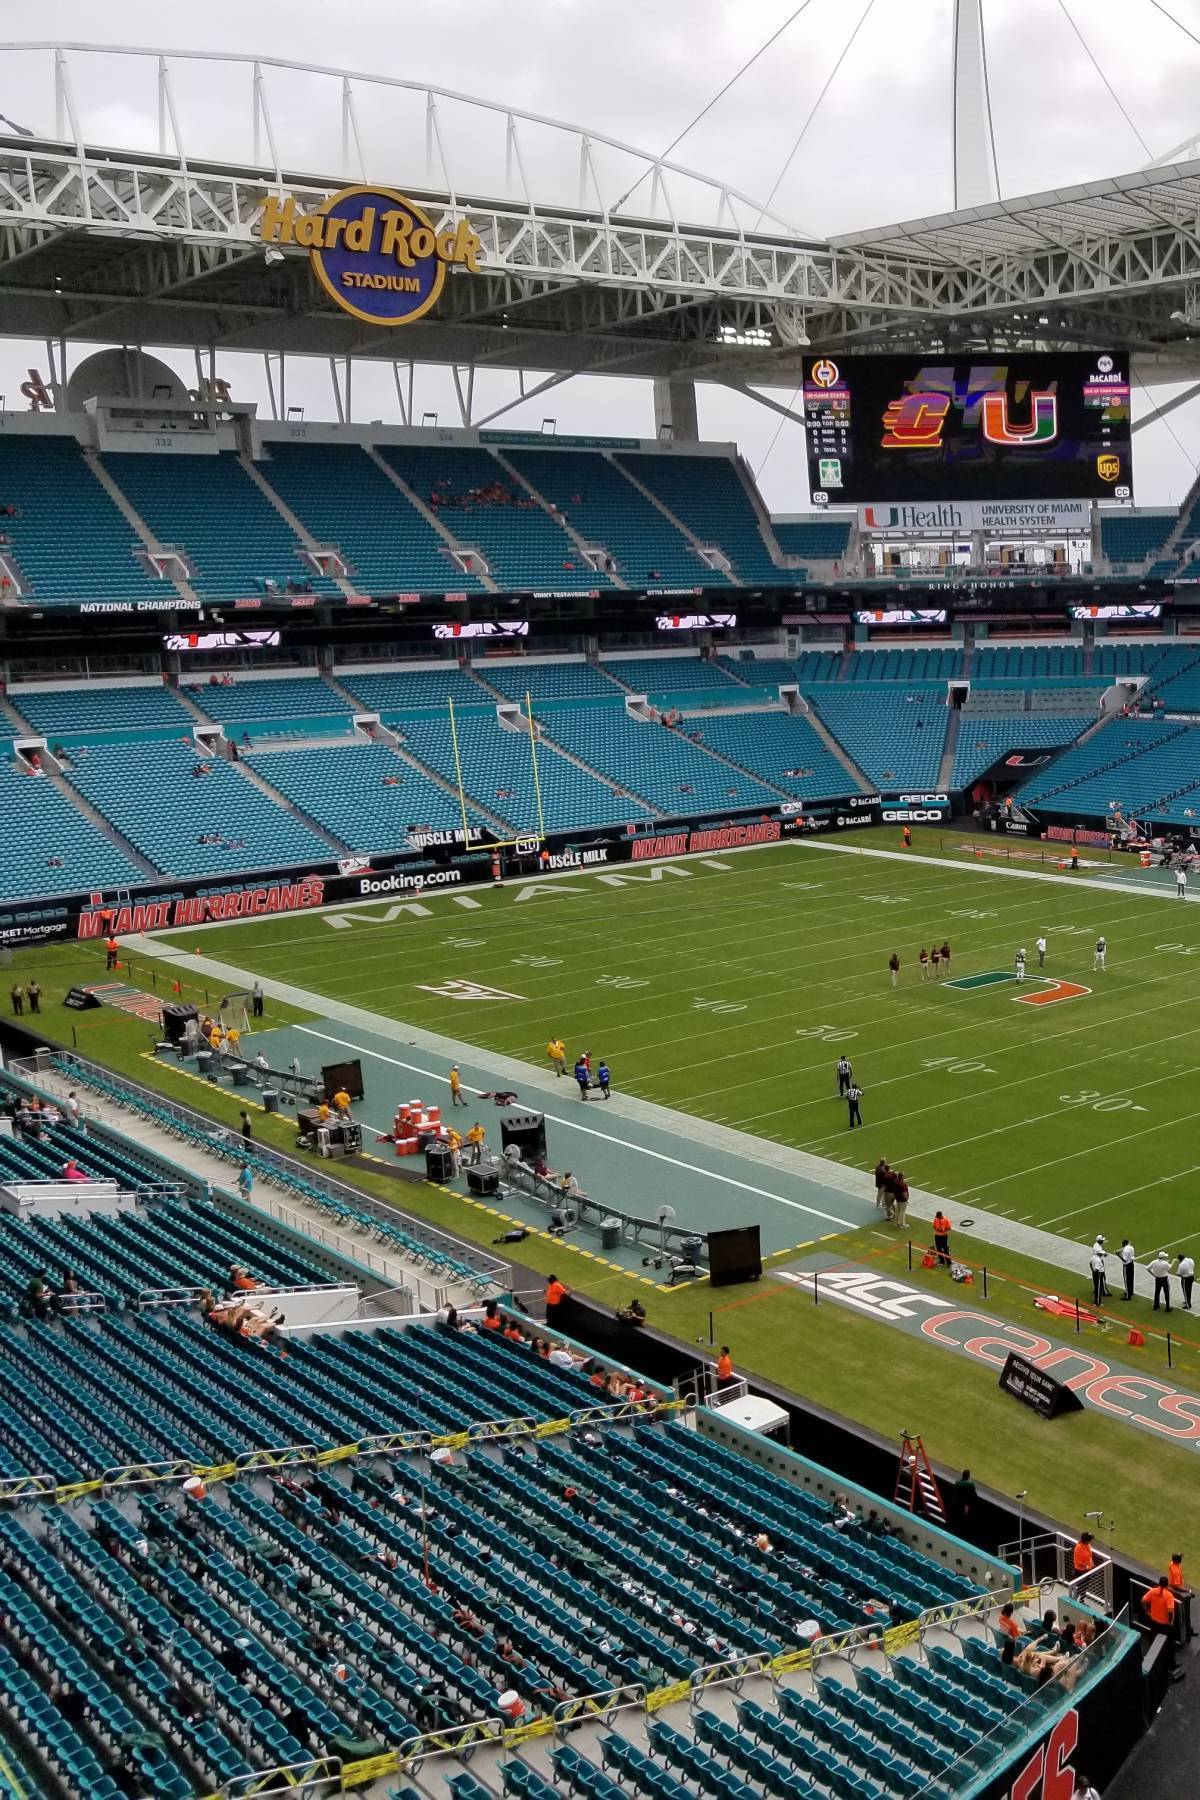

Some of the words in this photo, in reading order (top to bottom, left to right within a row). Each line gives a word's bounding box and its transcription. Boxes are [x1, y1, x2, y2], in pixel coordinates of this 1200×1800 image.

[261, 196, 375, 252] Hard
[380, 209, 480, 273] Rock
[342, 271, 420, 293] STADIUM
[1100, 462, 1118, 477] ups
[982, 504, 1035, 515] UNIVERSITY
[1037, 504, 1049, 513] OF
[1051, 503, 1083, 514] MIAMI
[982, 516, 1017, 526] HEALTH
[1018, 515, 1056, 526] SYSTEM
[970, 581, 1015, 589] HONOR
[80, 602, 134, 612] NATIONAL
[137, 600, 202, 610] CHAMPIONS
[900, 794, 948, 803] GEICO
[846, 814, 872, 825] BACARDÍ
[882, 810, 942, 821] GEICO
[1005, 822, 1027, 831] Canon
[409, 830, 453, 847] MUSCLE
[632, 832, 686, 861] MIAMI
[689, 822, 781, 852] HURRICANES
[583, 848, 608, 864] MILK
[360, 869, 461, 894] Booking.com
[322, 859, 734, 928] MIAMI
[174, 882, 324, 926] HURRICANES
[23, 923, 68, 935] Mortgage
[595, 974, 650, 990] 30
[691, 997, 748, 1014] 40
[795, 1024, 859, 1042] 50
[919, 1055, 987, 1075] 40
[1059, 1090, 1134, 1112] 30
[773, 1269, 957, 1320] ACC
